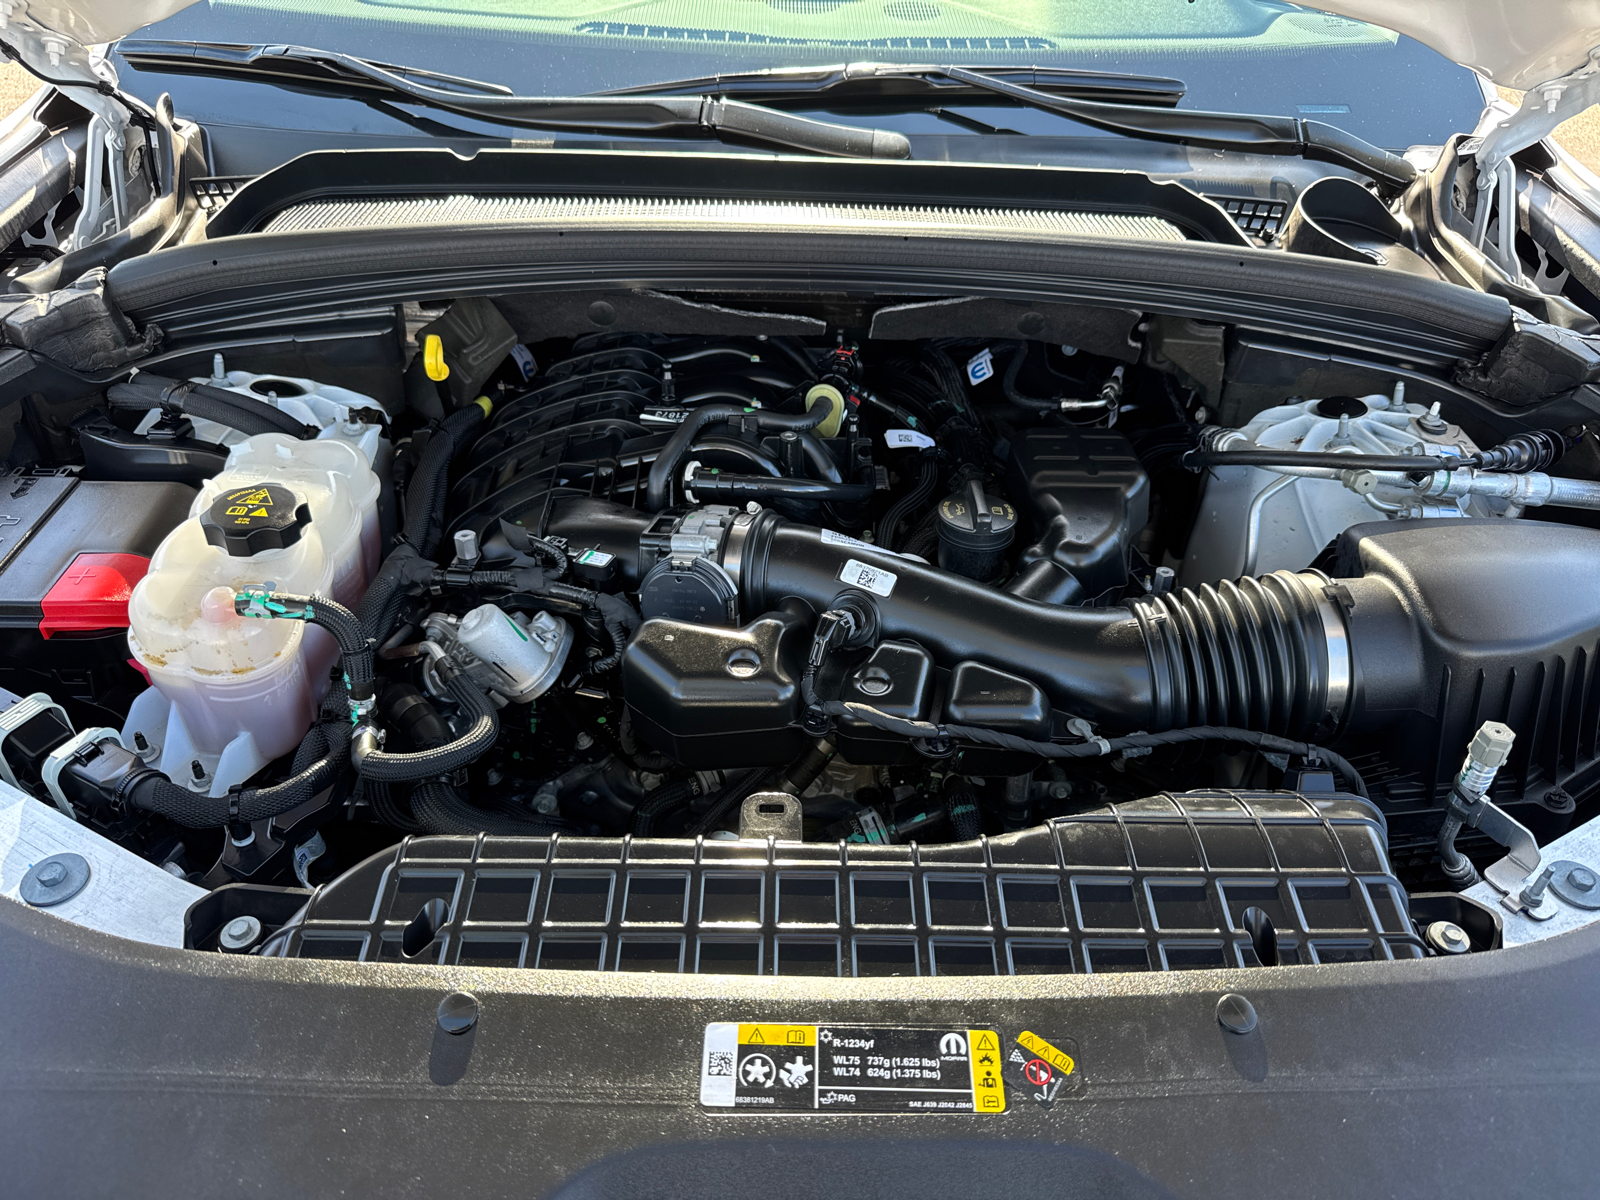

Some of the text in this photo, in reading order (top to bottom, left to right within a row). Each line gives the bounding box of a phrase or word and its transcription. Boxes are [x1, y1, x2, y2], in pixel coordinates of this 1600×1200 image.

[688, 776, 700, 795] ENG
[833, 1038, 875, 1050] R-1234yf
[833, 1055, 940, 1069] WL75 737g (1.625 lbs)
[833, 1067, 941, 1080] WL74 624g (1.375 lbs)
[838, 1093, 856, 1102] PAG
